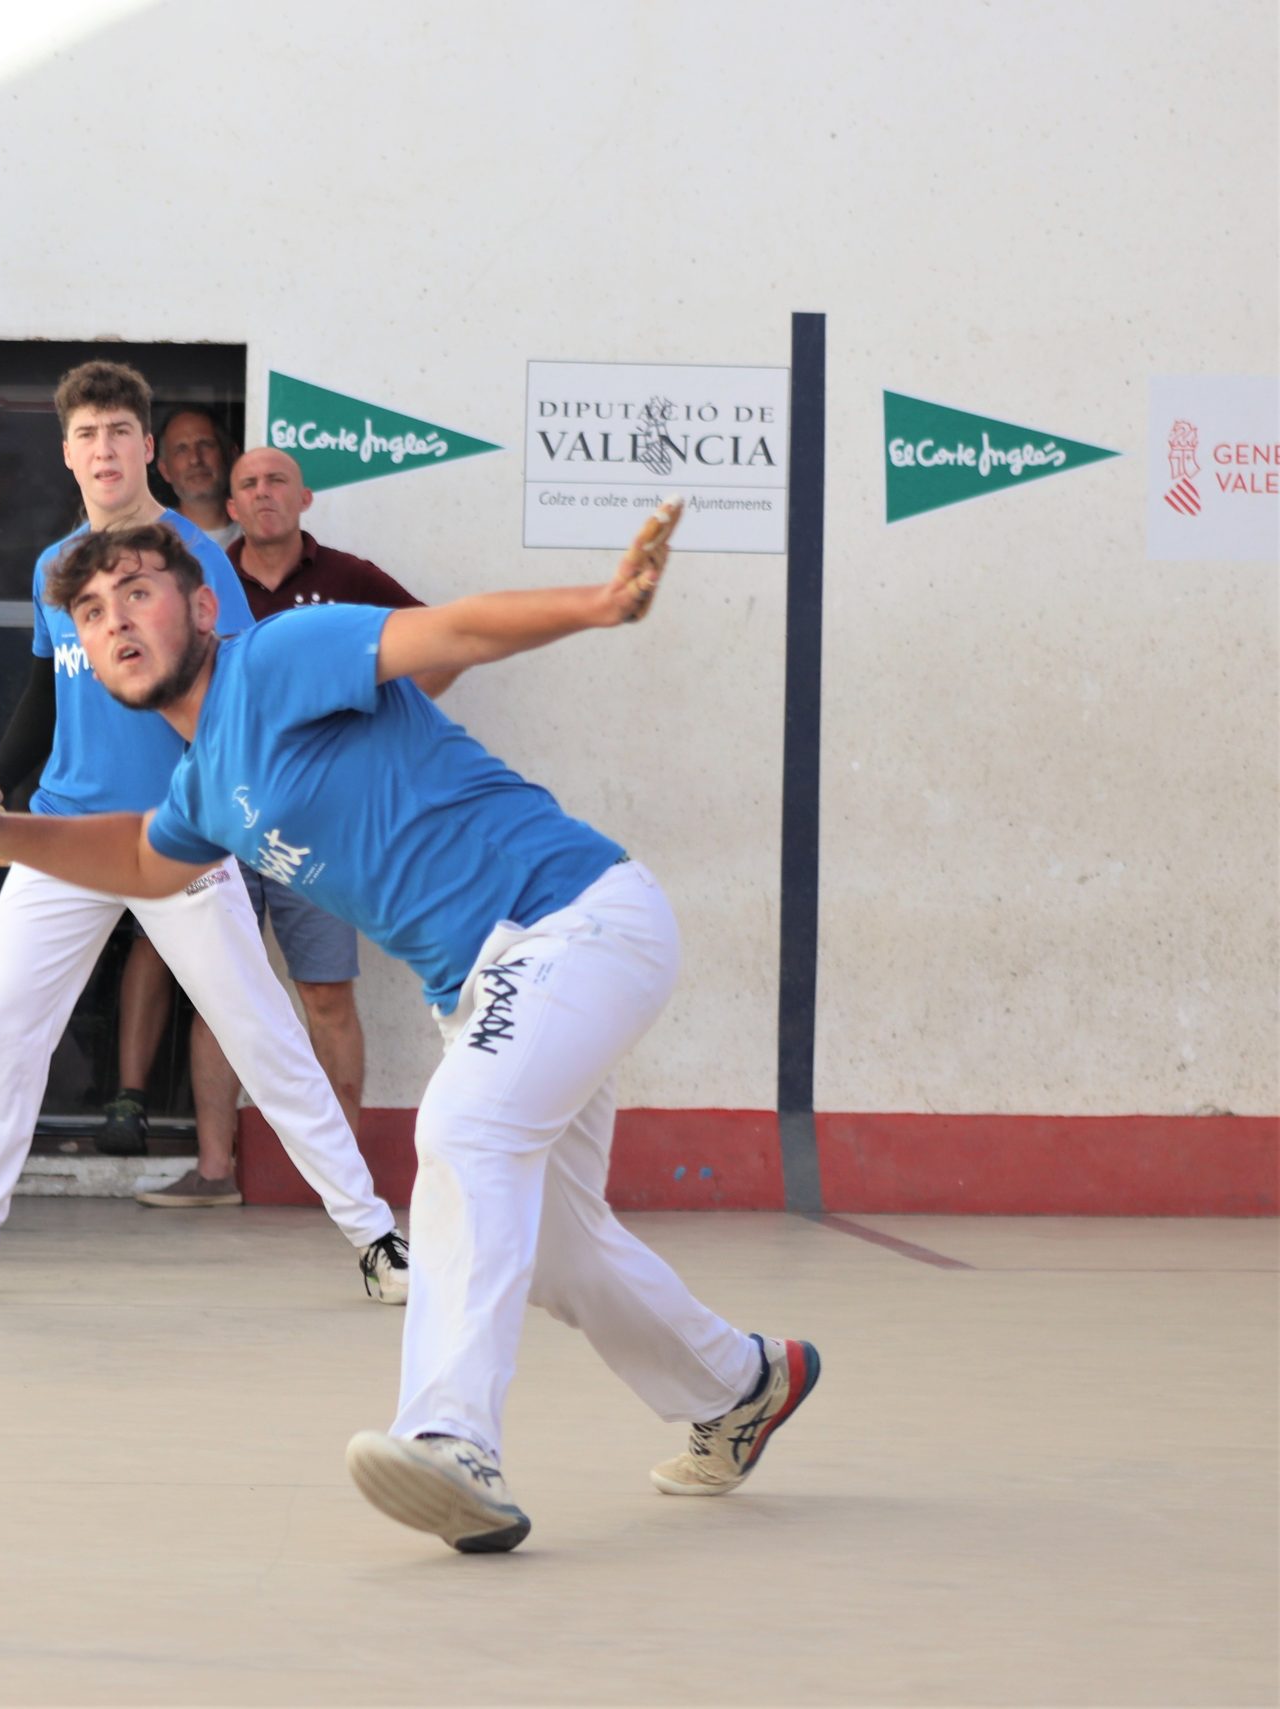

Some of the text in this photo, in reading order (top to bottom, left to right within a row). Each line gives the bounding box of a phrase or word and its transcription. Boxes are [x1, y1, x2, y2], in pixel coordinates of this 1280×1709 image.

[538, 400, 775, 423] DIPUTACIÓ DE
[271, 418, 448, 464] El Corte Inglés
[888, 432, 1066, 477] El Corte Inglés
[538, 491, 576, 506] Colze
[580, 495, 589, 506] a
[593, 494, 628, 507] colze
[632, 495, 663, 508] amb
[688, 495, 773, 513] Ajuntaments
